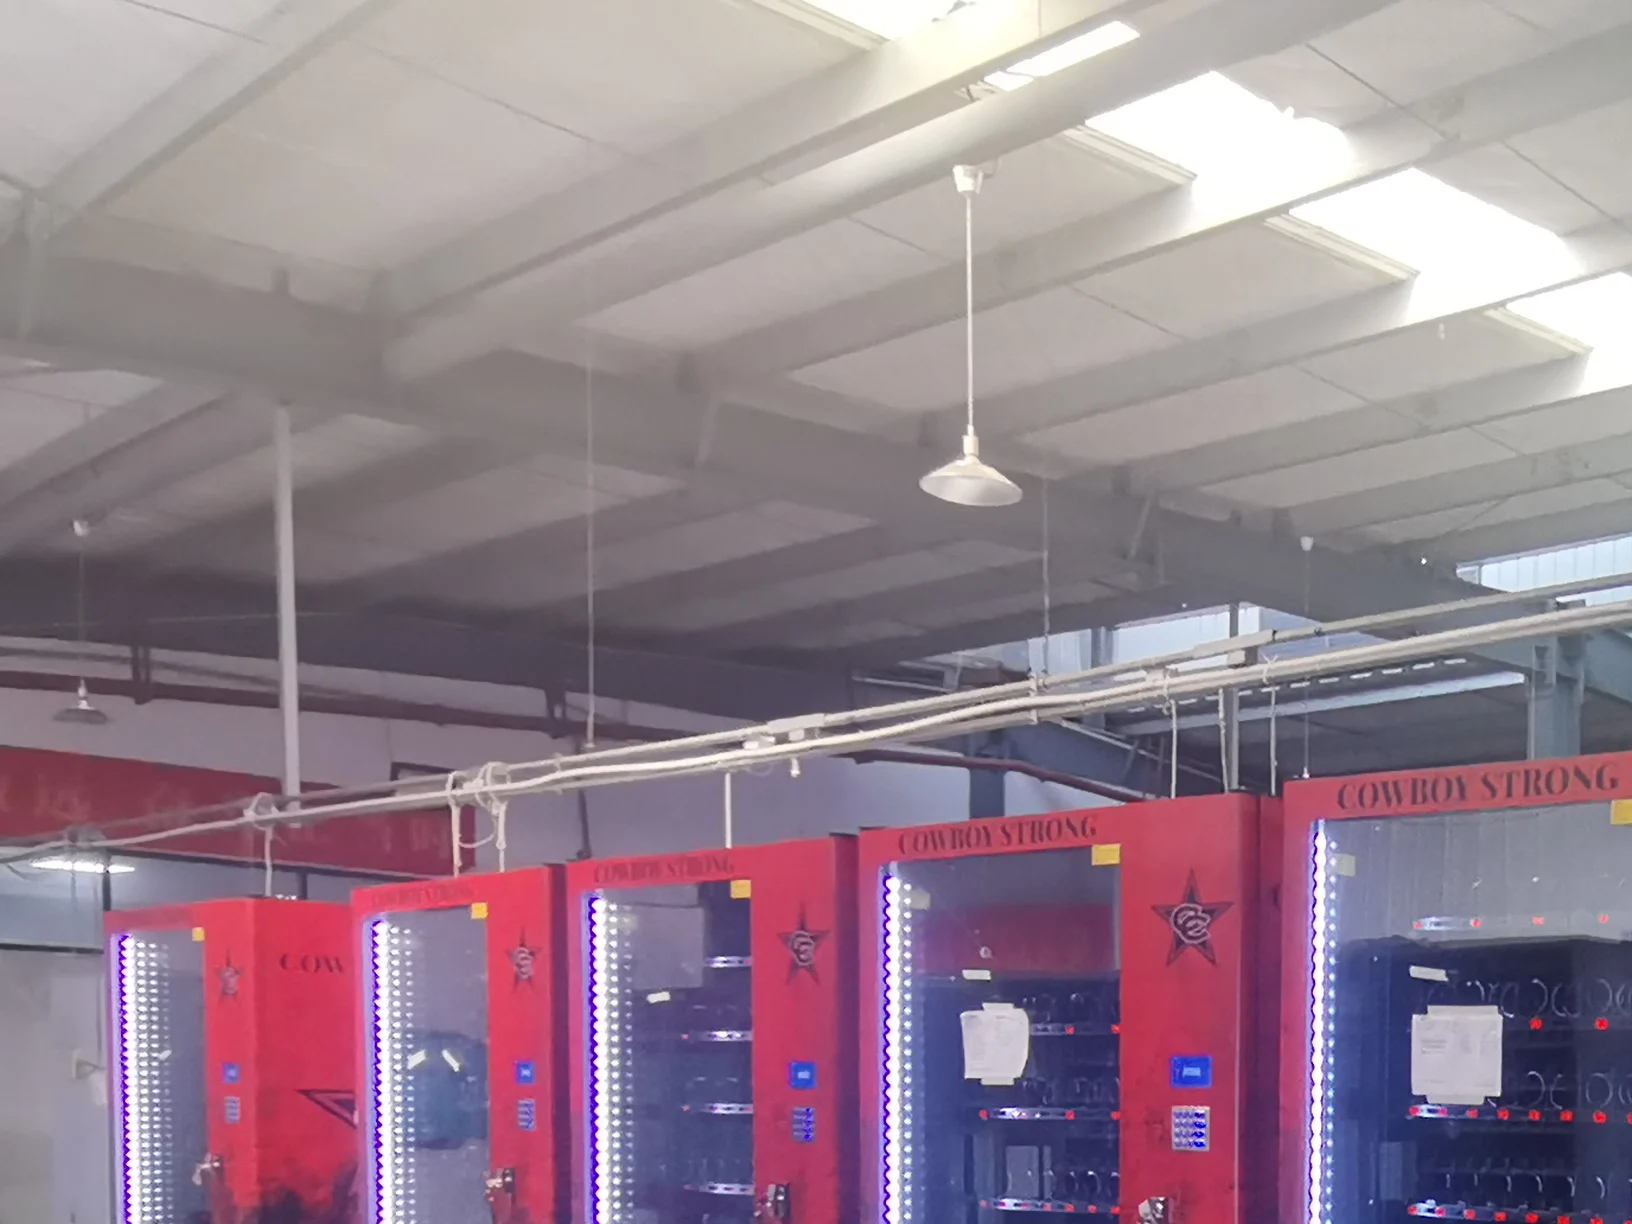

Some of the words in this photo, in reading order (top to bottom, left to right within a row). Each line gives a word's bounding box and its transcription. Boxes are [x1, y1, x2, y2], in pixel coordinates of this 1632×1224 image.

[1337, 775, 1468, 811] COWBOY
[1480, 762, 1619, 801] STRONG
[898, 825, 992, 855] COWBOY
[1000, 815, 1097, 847] STRONG
[279, 952, 345, 974] COW
